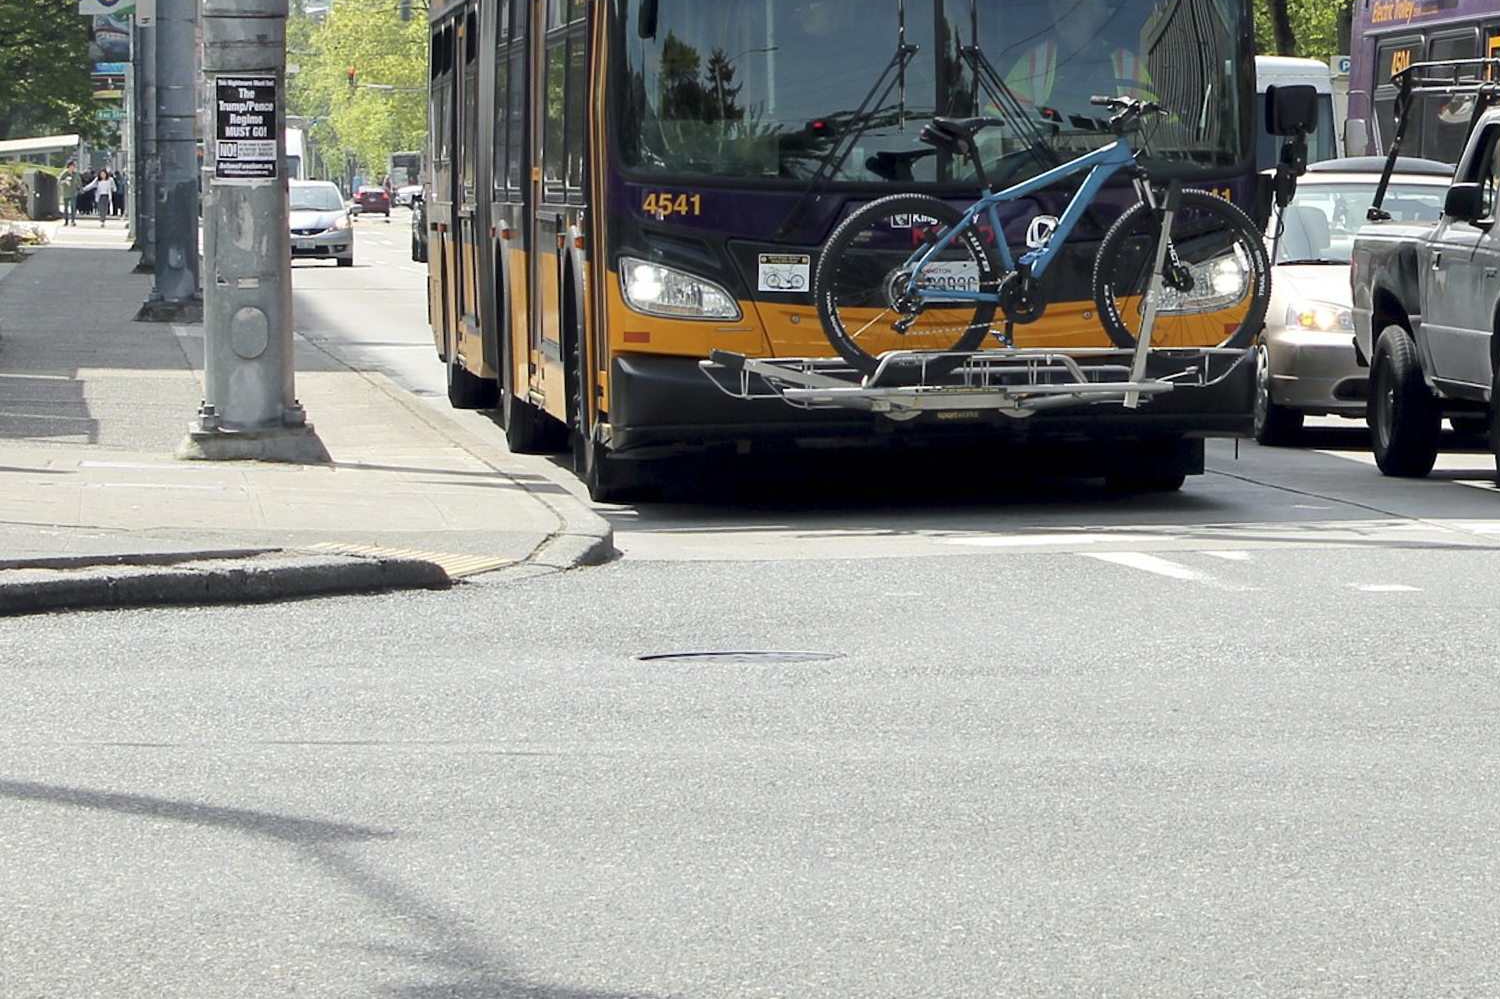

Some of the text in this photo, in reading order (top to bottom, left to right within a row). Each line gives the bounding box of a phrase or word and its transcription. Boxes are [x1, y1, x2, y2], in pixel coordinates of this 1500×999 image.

[238, 88, 255, 98] The
[219, 100, 274, 113] Trump/Pence
[230, 113, 263, 126] Regime
[225, 126, 267, 137] MUST GO!
[220, 143, 237, 157] NO!
[643, 193, 700, 215] 4541
